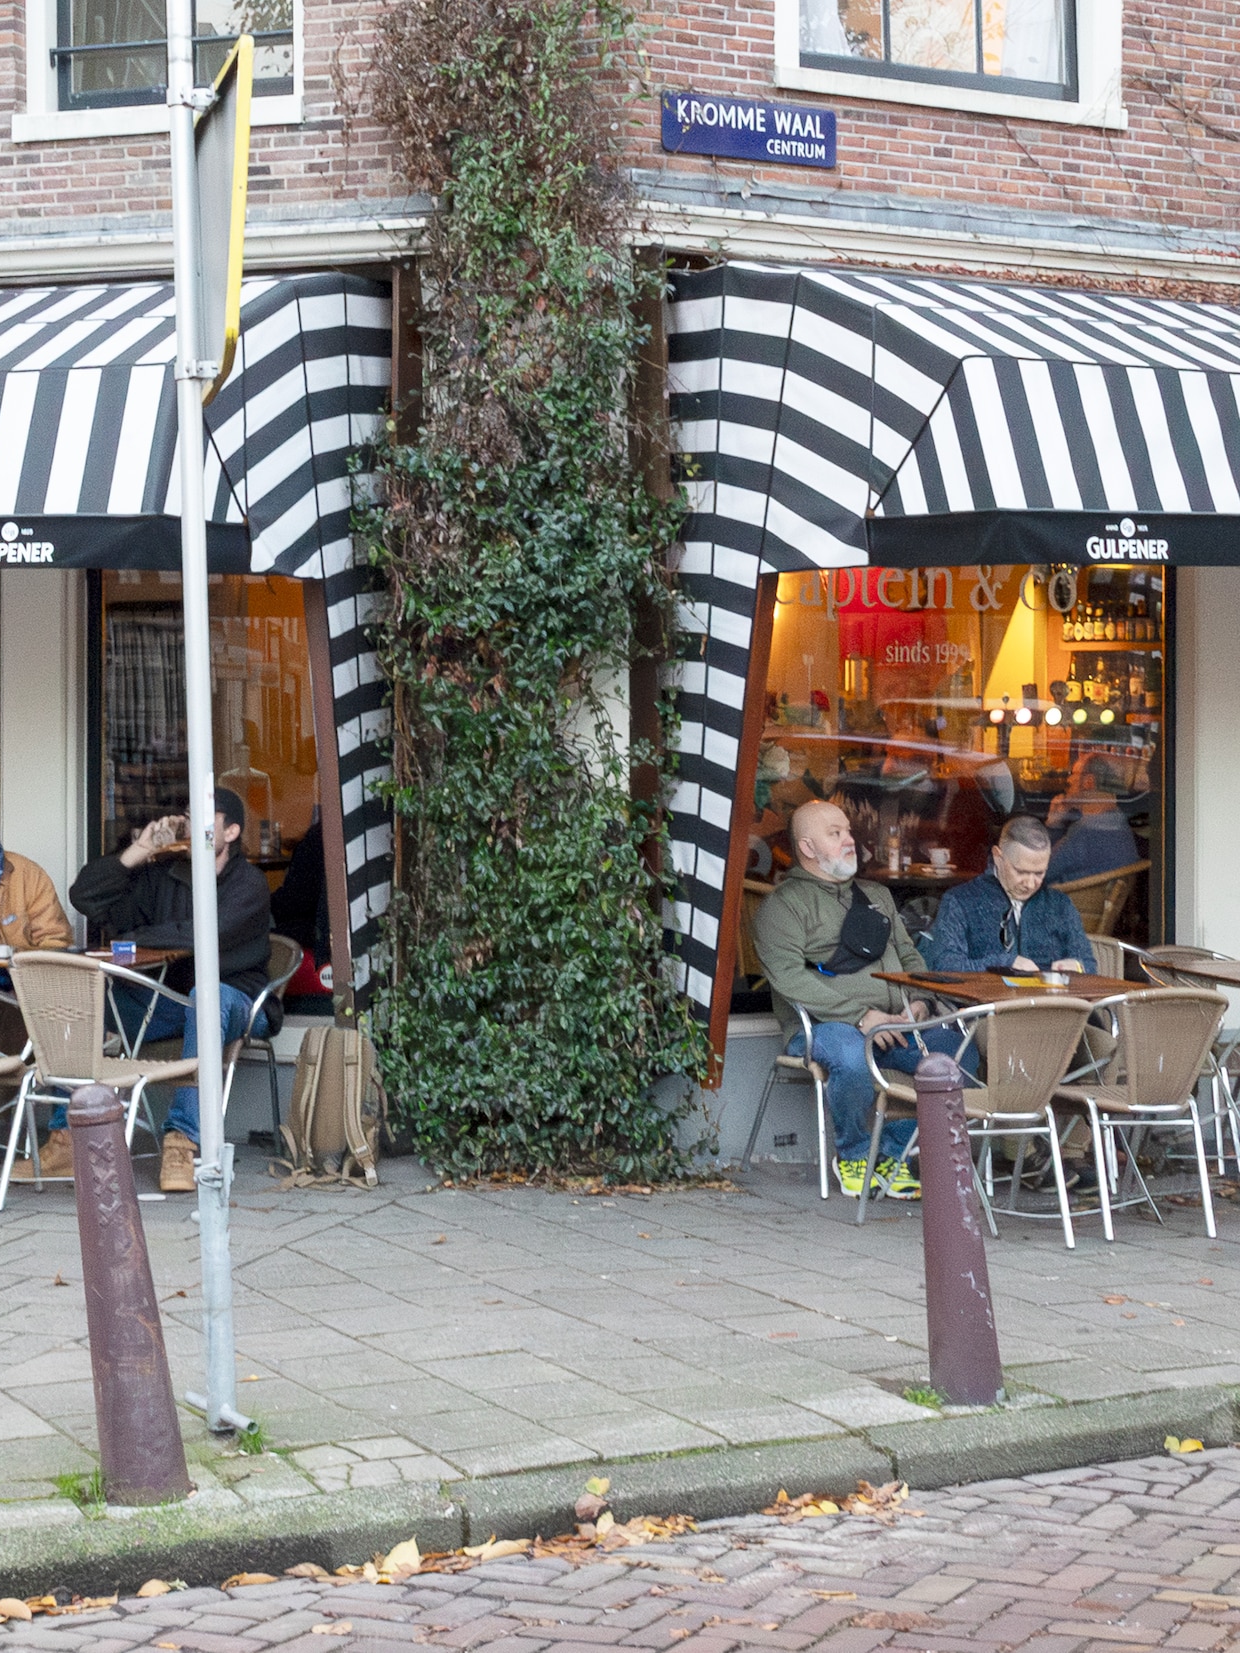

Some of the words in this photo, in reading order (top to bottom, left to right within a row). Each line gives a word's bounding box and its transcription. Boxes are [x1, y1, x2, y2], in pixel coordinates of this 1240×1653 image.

[677, 98, 766, 133] KROMME
[774, 109, 826, 140] WAAL
[766, 138, 826, 160] CENTRUM
[1086, 536, 1169, 560] GULPENER
[775, 566, 952, 621] aptein
[968, 564, 1004, 612] &
[885, 639, 931, 663] sinds
